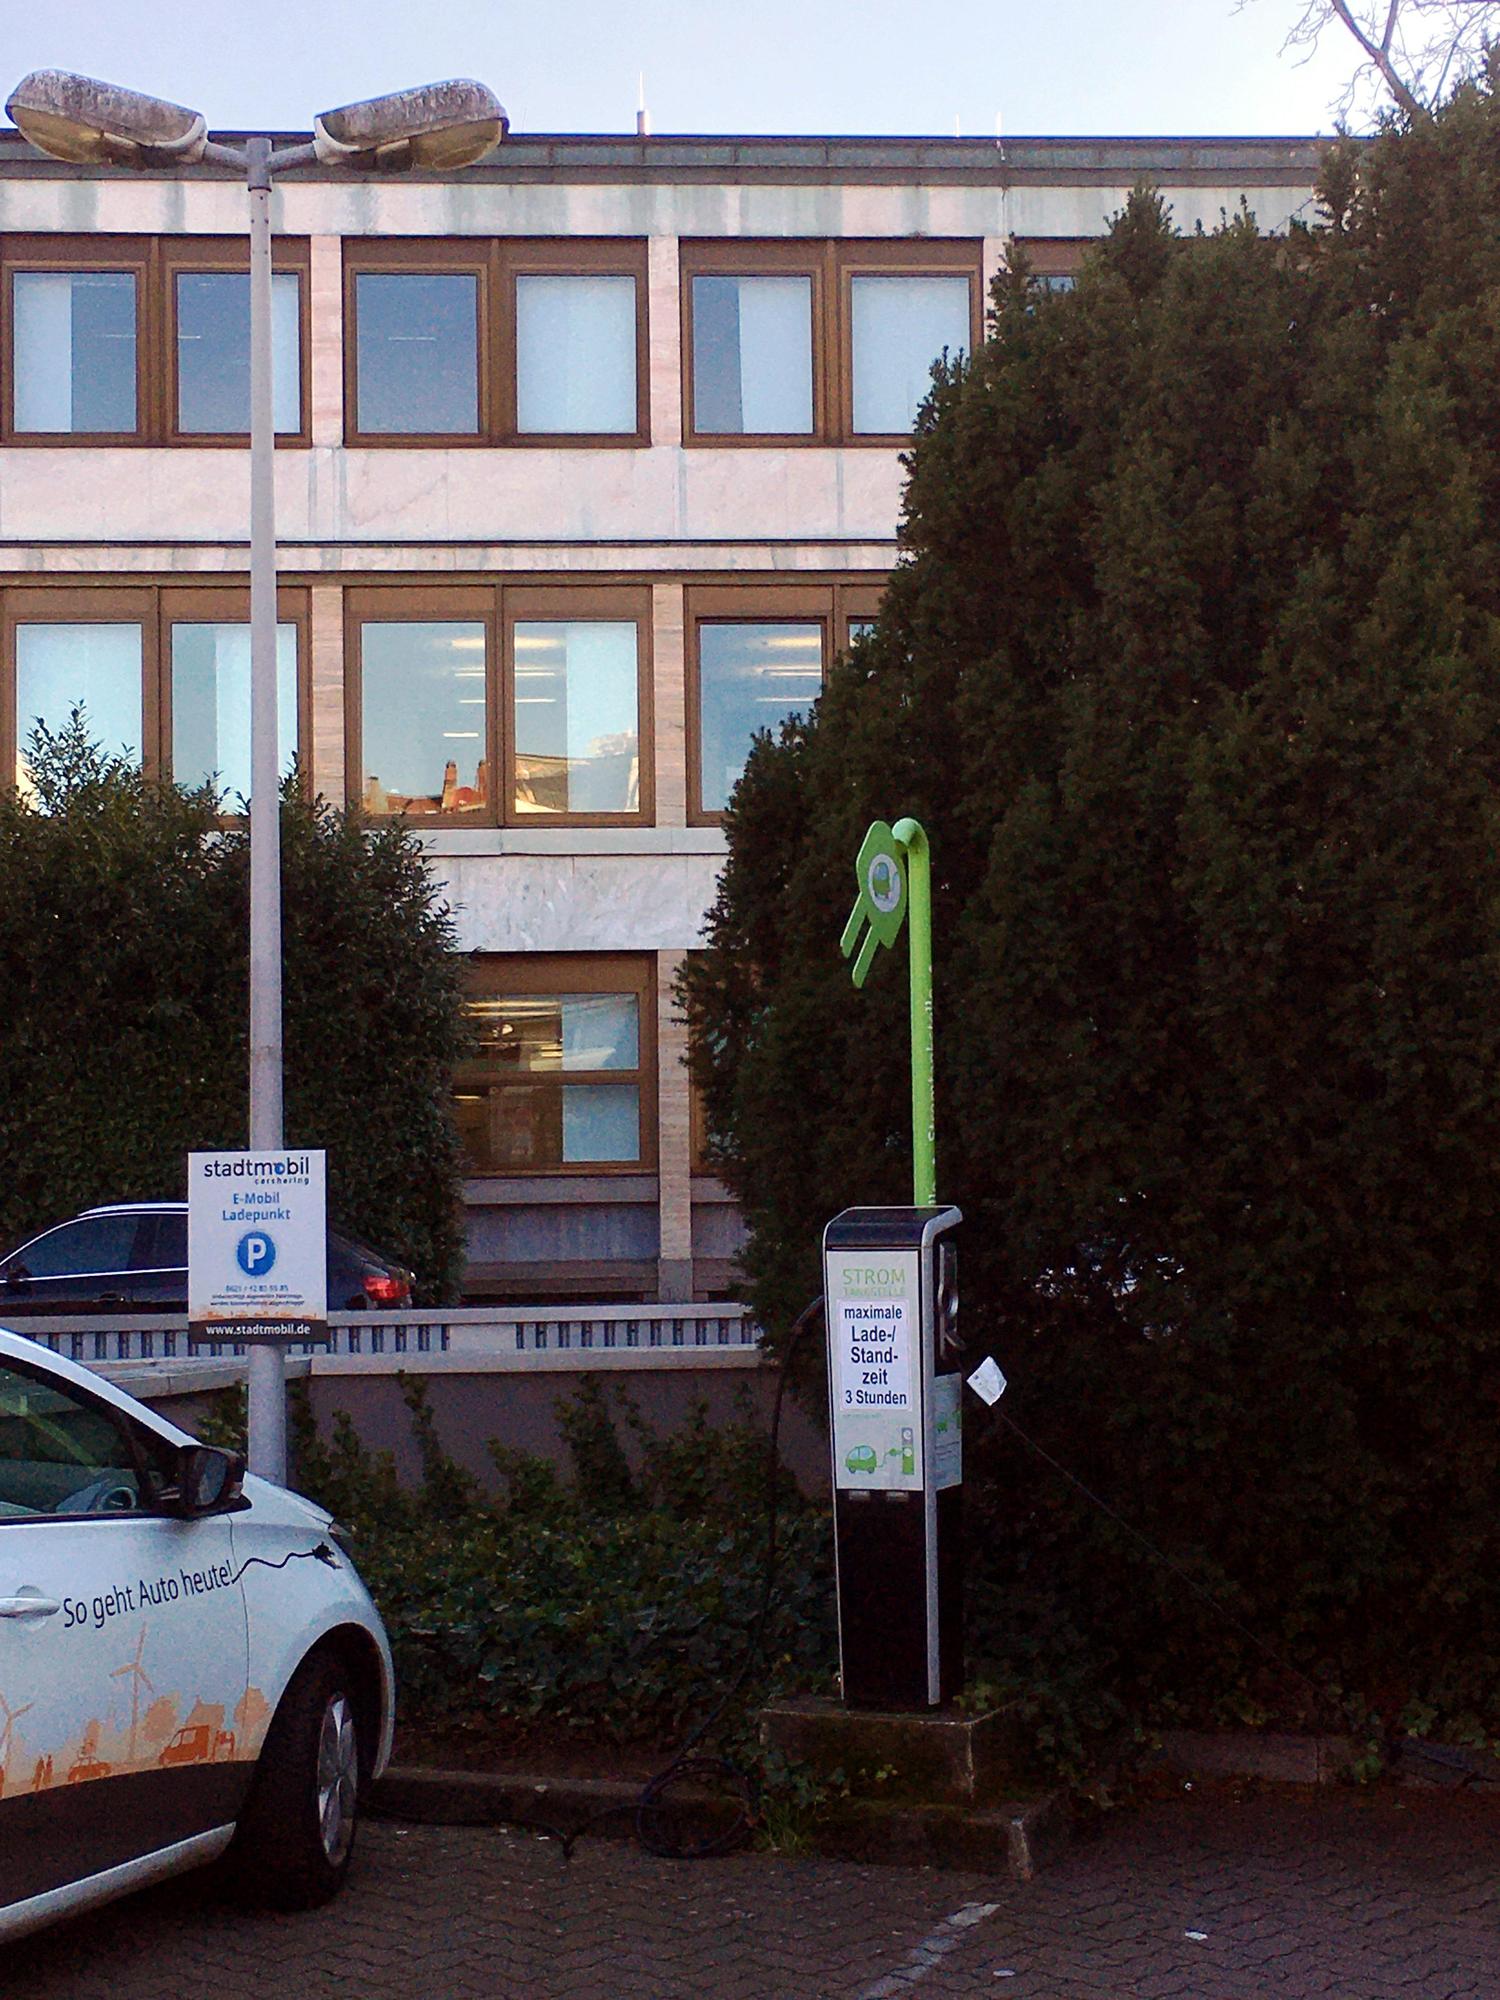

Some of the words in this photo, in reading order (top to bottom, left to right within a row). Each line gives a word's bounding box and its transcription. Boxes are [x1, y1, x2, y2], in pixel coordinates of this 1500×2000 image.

[204, 1156, 309, 1177] stadtmobil
[233, 1192, 280, 1205] E-Mobil
[222, 1208, 291, 1223] Ladepunkt
[247, 1238, 267, 1269] P
[842, 1268, 906, 1285] STROM
[844, 1304, 902, 1319] maximale
[205, 1323, 311, 1336] www.stadtmobil.de
[851, 1325, 897, 1342] Lade-/
[850, 1346, 898, 1364] Stand-
[862, 1368, 888, 1385] zeit
[845, 1390, 853, 1404] 3
[856, 1390, 907, 1405] Stunden
[63, 1598, 87, 1628] So
[93, 1585, 135, 1628] geht
[139, 1577, 179, 1608] Auto
